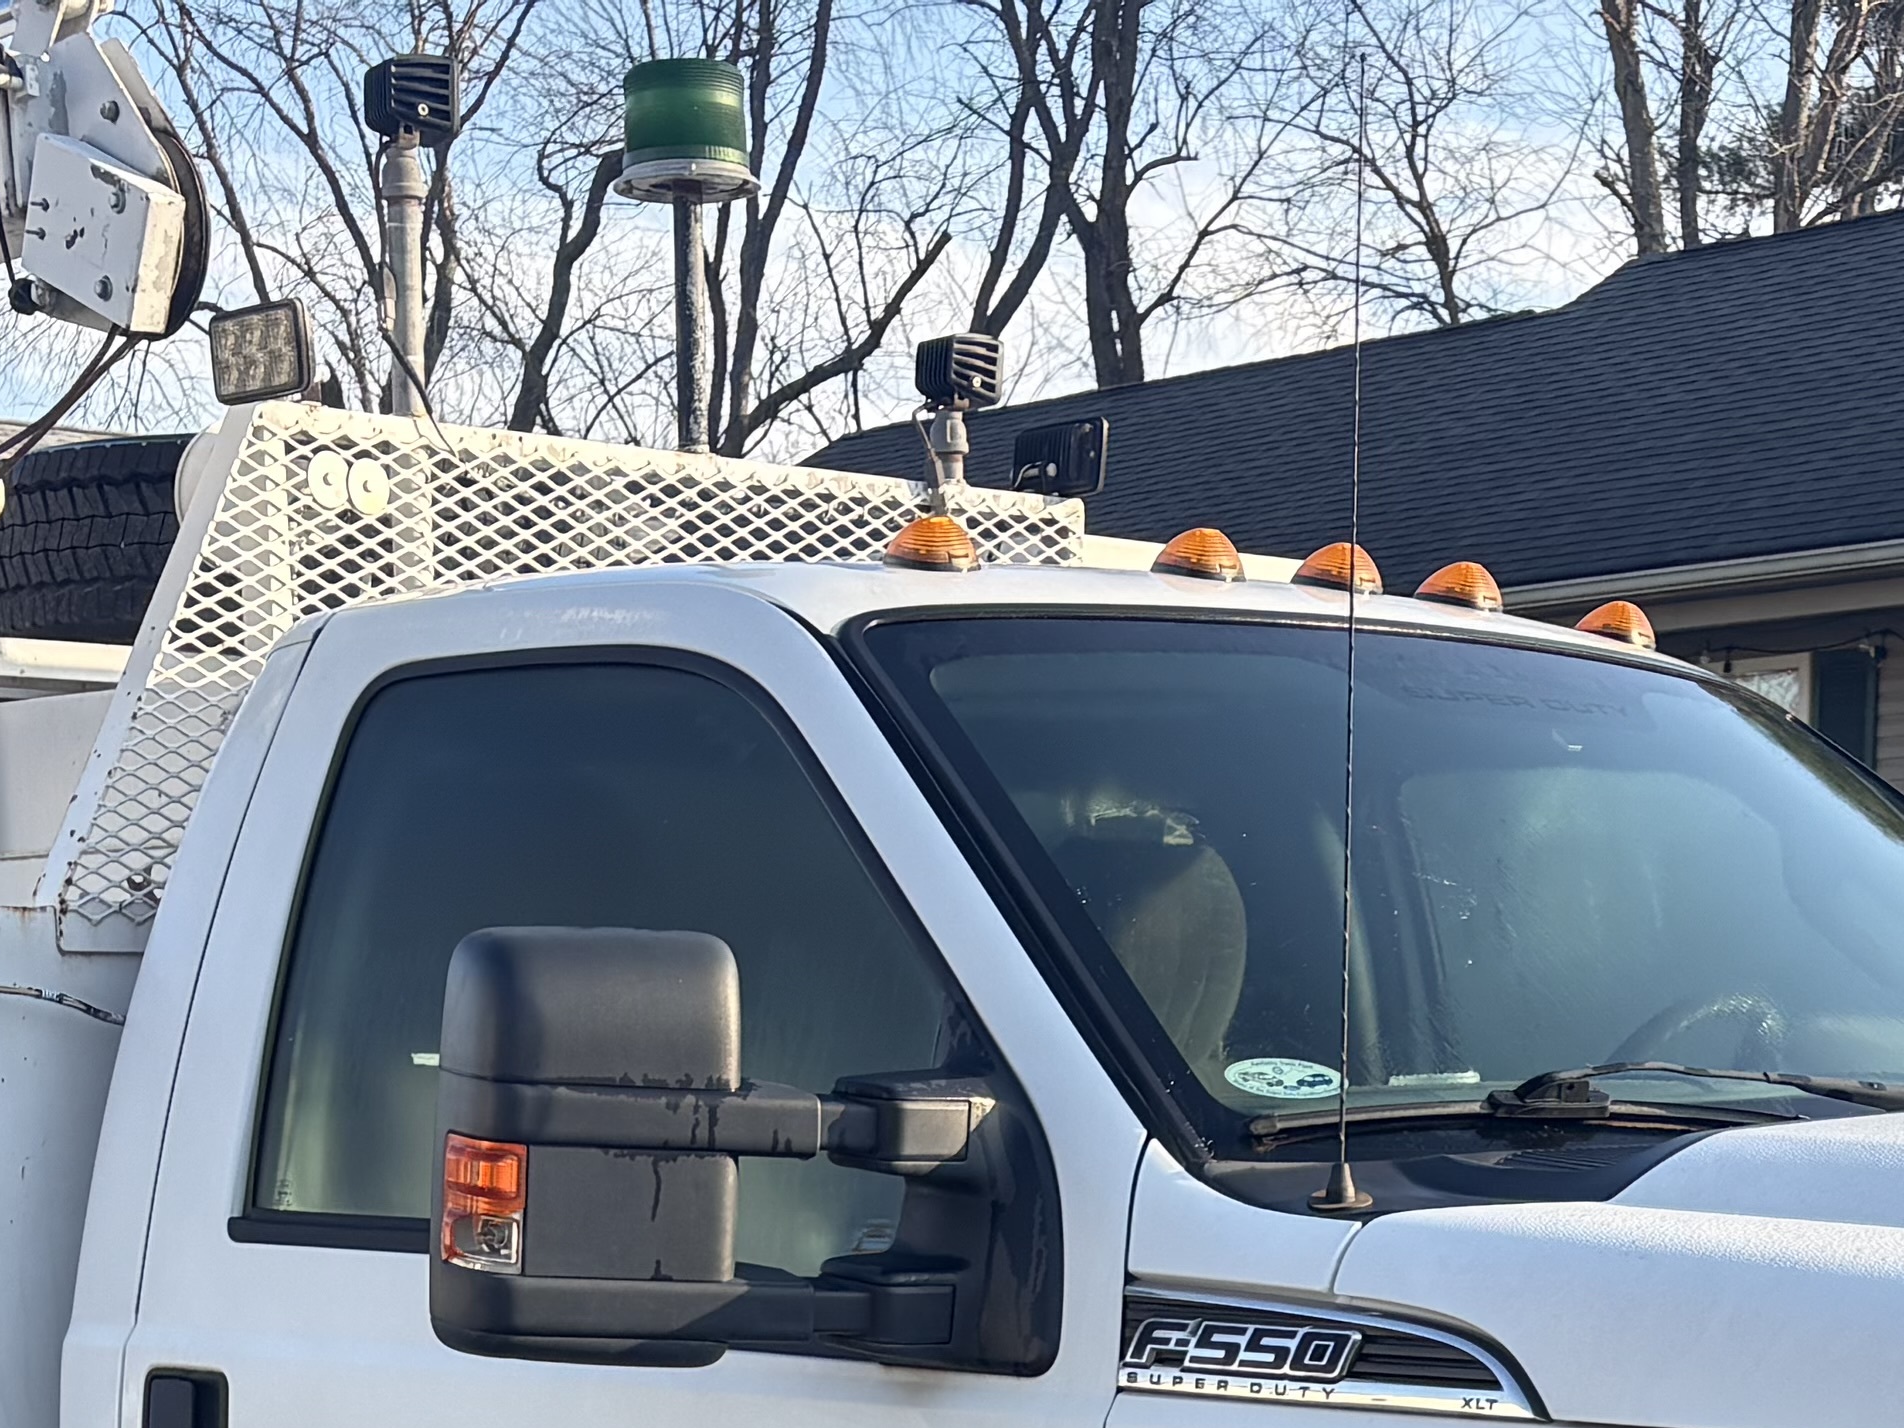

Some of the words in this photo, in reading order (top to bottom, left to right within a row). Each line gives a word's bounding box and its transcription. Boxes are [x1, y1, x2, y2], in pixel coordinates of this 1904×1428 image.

[1121, 1317, 1362, 1382] F-550
[1125, 1371, 1231, 1392] SUPER
[1249, 1381, 1337, 1401] DUTY
[1461, 1397, 1499, 1412] XLT
